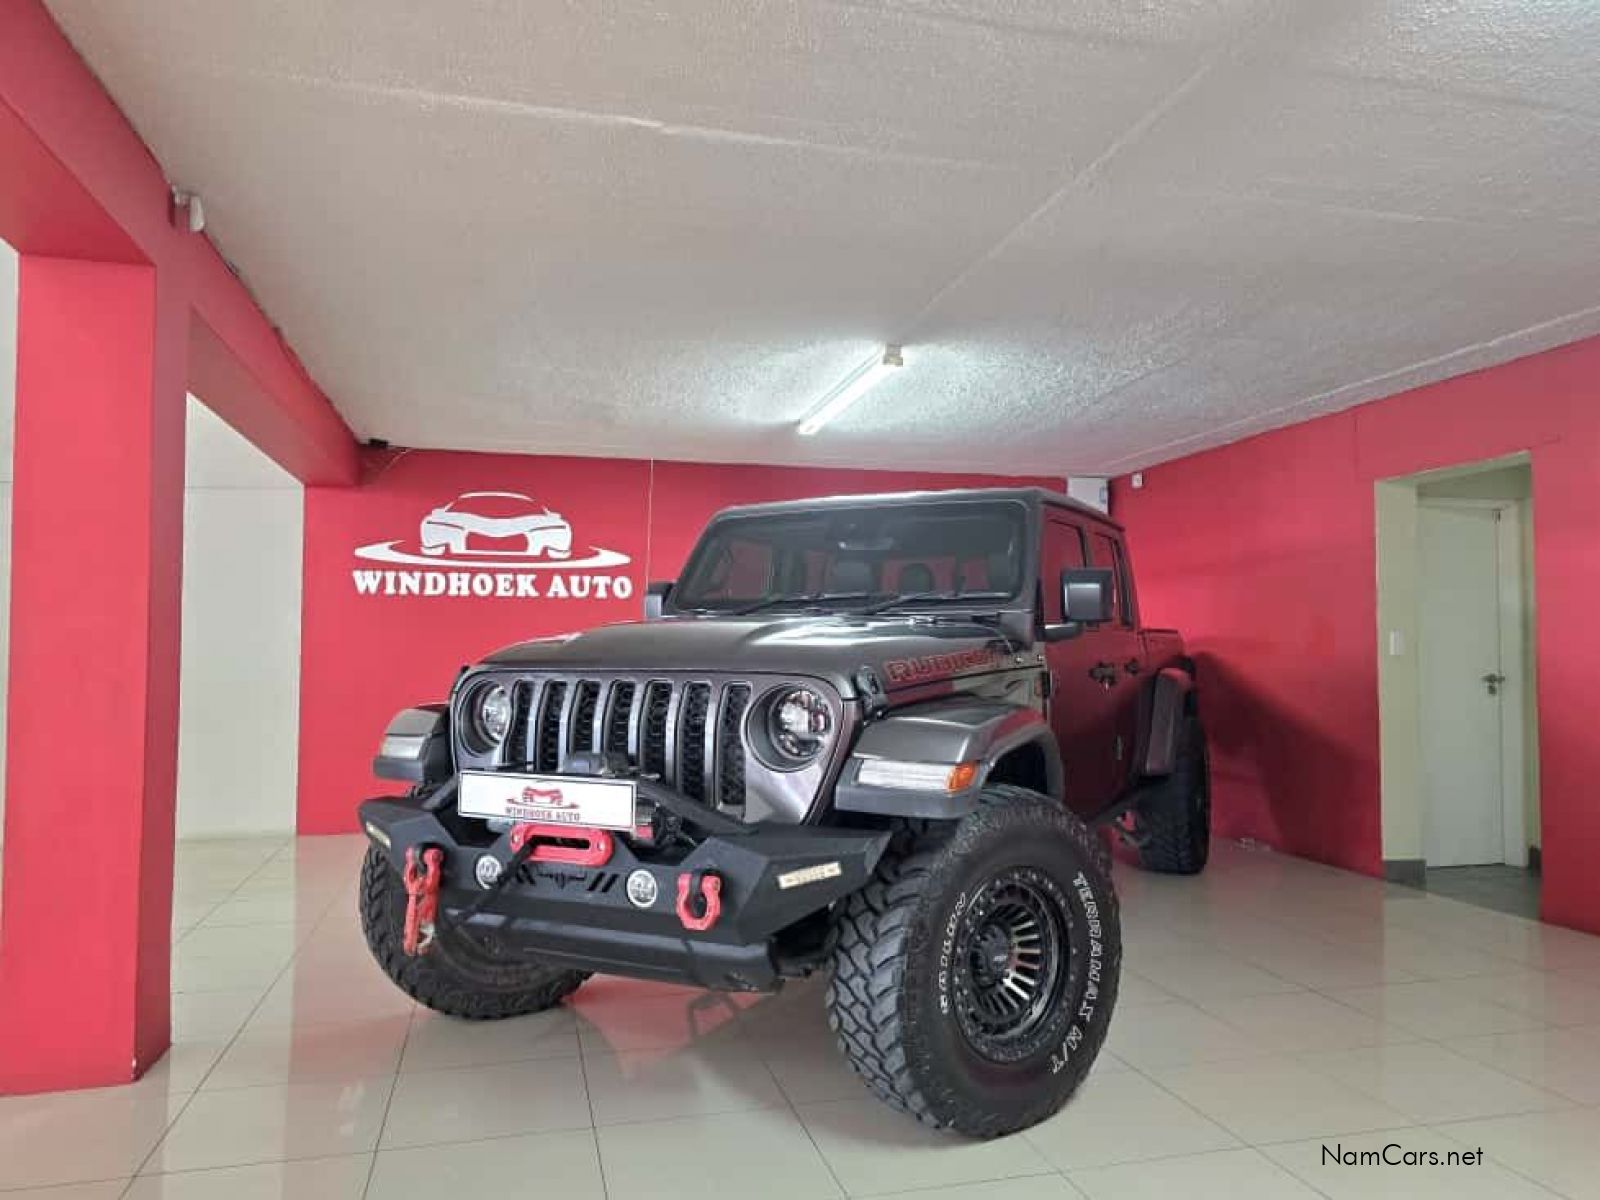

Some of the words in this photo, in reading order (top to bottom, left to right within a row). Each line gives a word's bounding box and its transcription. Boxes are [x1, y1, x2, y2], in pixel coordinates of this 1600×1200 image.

[353, 569, 540, 597] WINDHOEK
[546, 575, 632, 599] AUTO
[556, 810, 582, 822] AUTO
